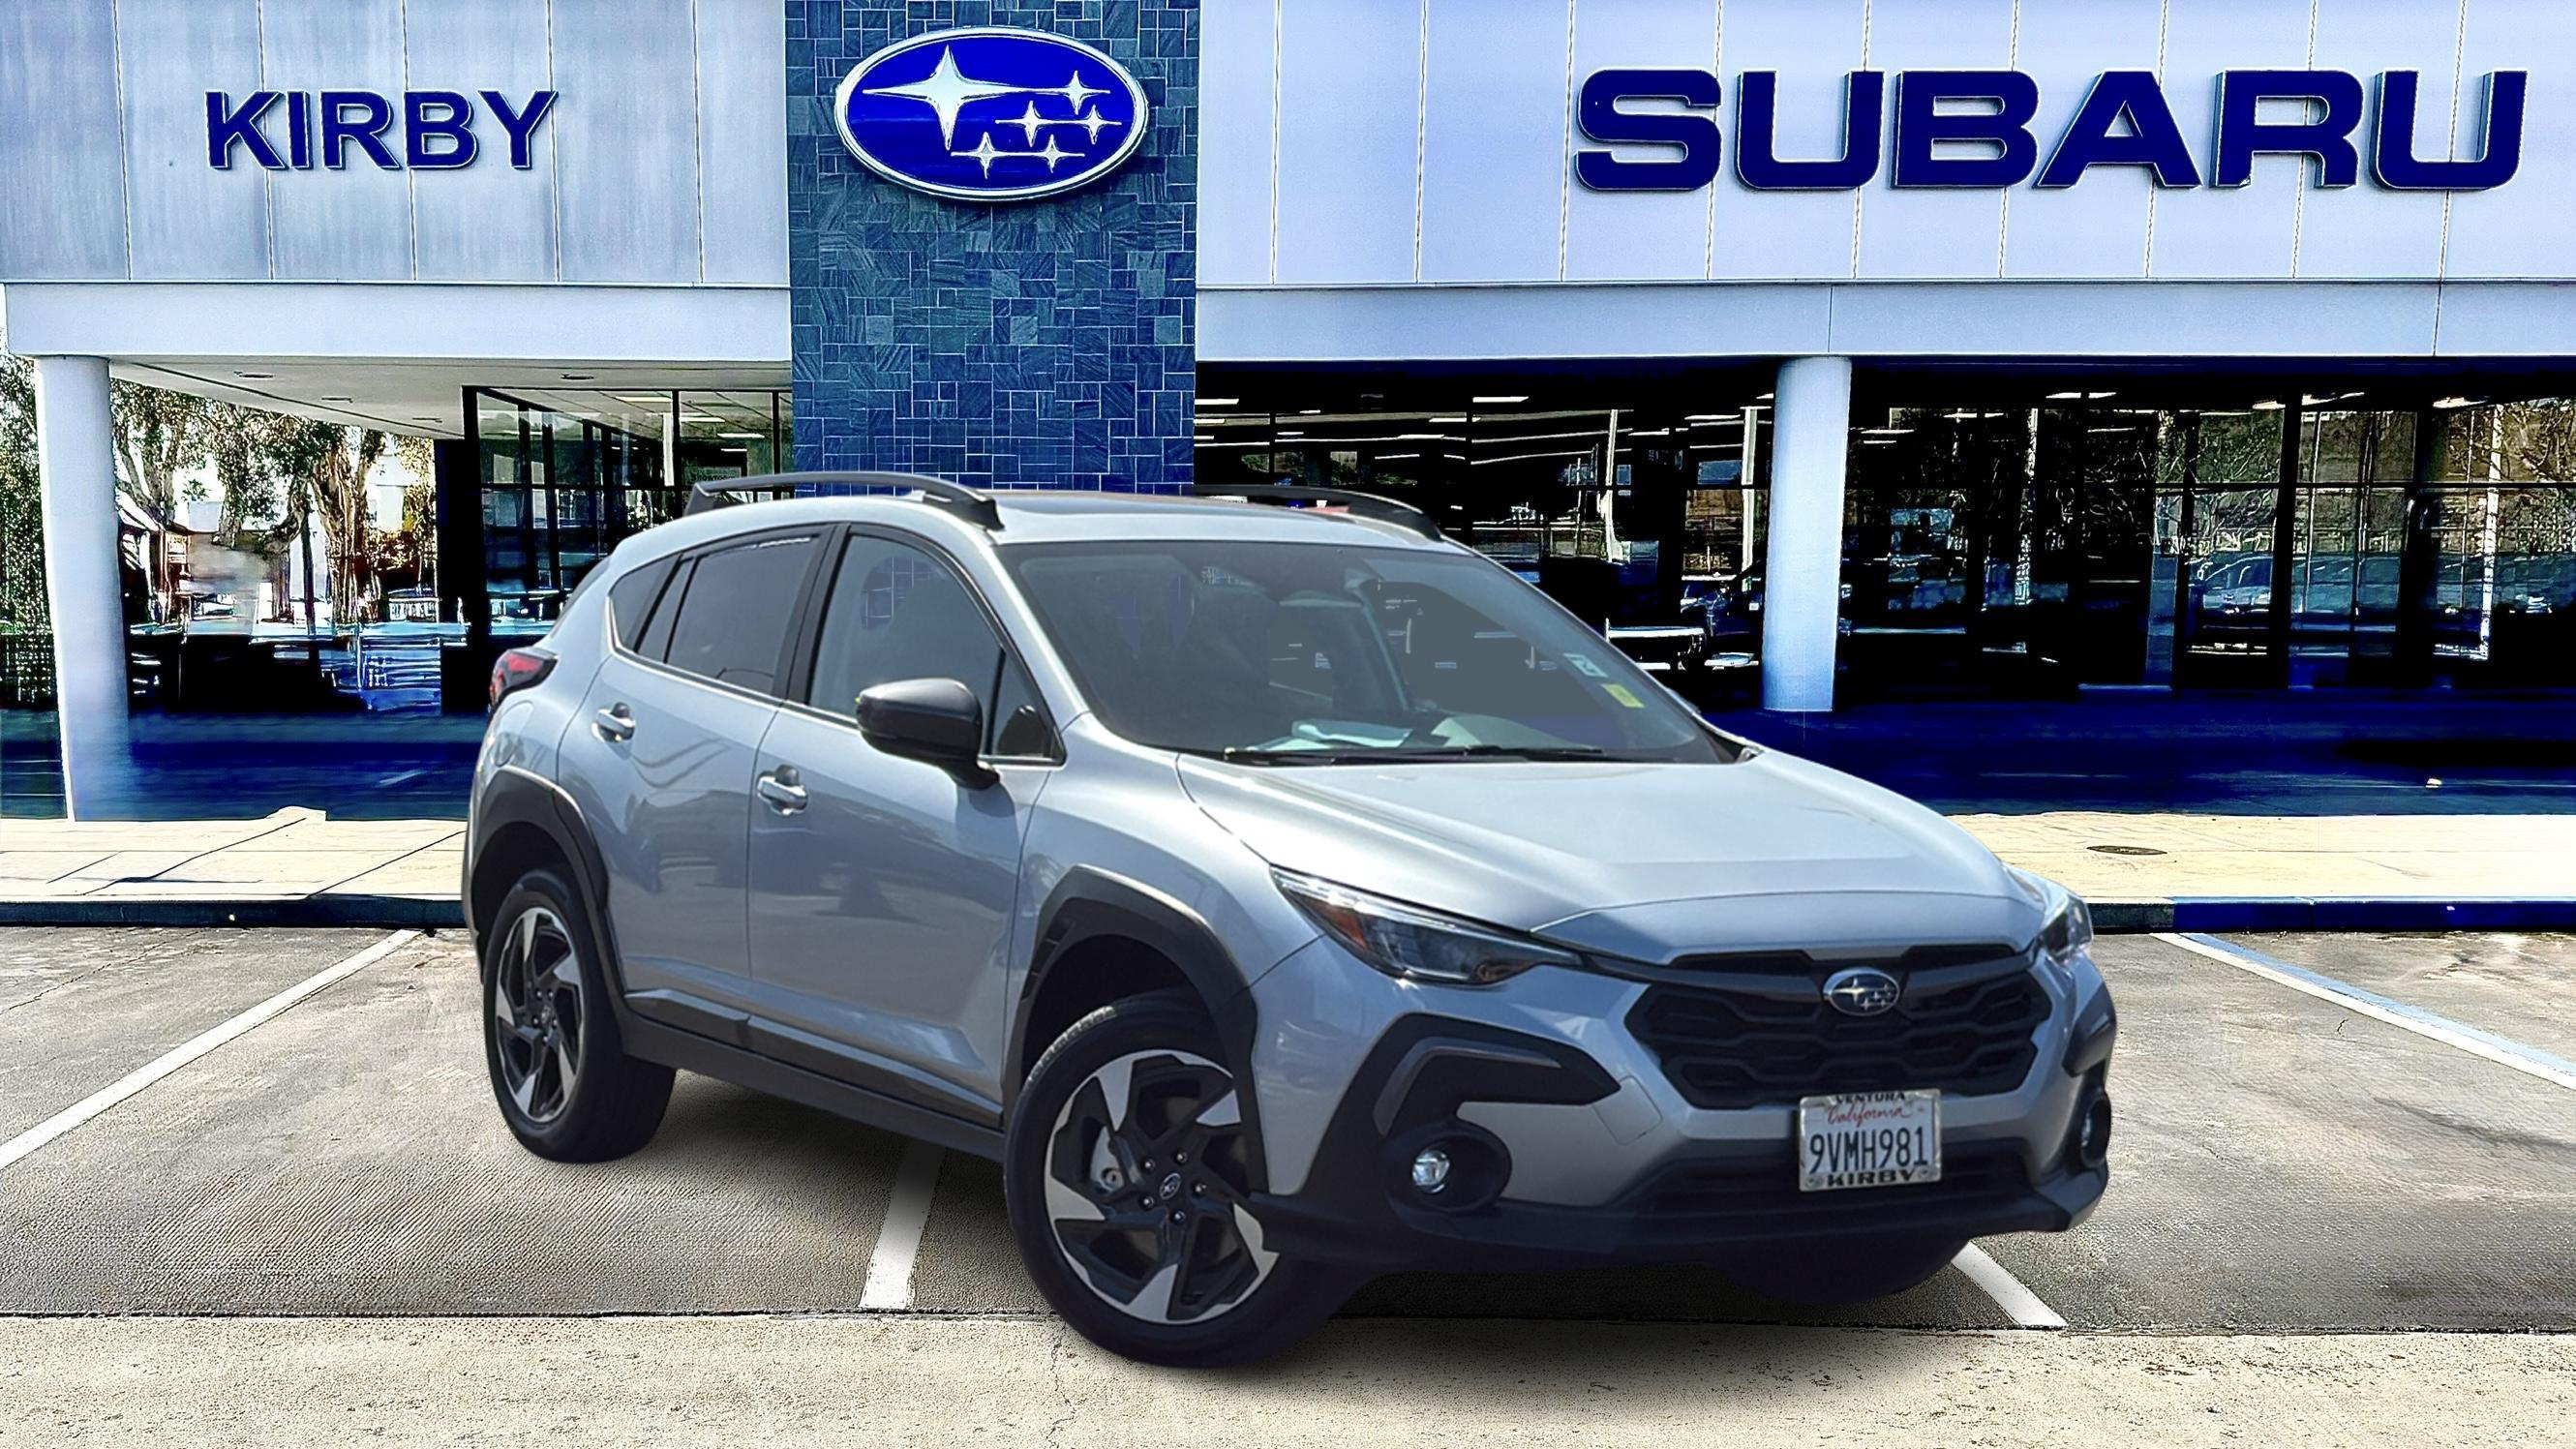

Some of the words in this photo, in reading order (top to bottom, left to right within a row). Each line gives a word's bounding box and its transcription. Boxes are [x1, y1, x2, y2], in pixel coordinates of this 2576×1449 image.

[204, 89, 559, 170] KIRBY
[1575, 68, 2528, 192] SUBARU
[1827, 1102, 1912, 1128] California
[1834, 1091, 1906, 1104] VENTURA
[1809, 1126, 1928, 1174] 9VMH981
[1827, 1167, 1916, 1188] KIRBY
